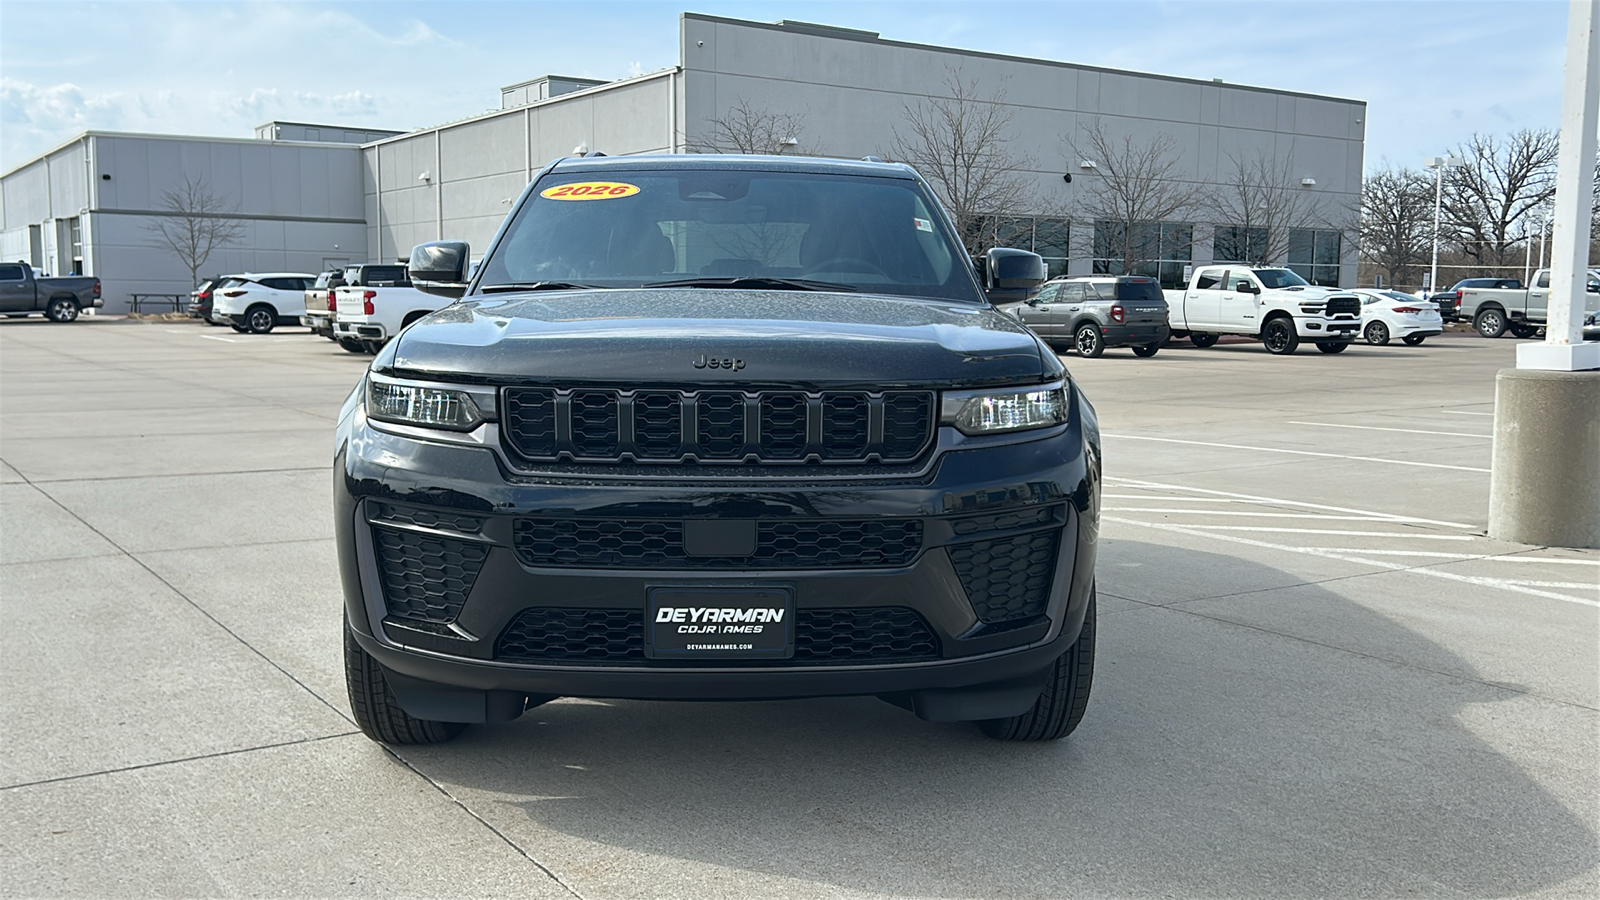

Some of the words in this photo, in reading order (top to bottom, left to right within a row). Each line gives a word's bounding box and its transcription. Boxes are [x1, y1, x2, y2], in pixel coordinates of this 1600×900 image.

[550, 186, 630, 197] 2026
[692, 354, 746, 372] Jeep
[655, 607, 785, 623] DEYARMAN
[677, 625, 717, 634] CDJR
[722, 625, 764, 634] AMES
